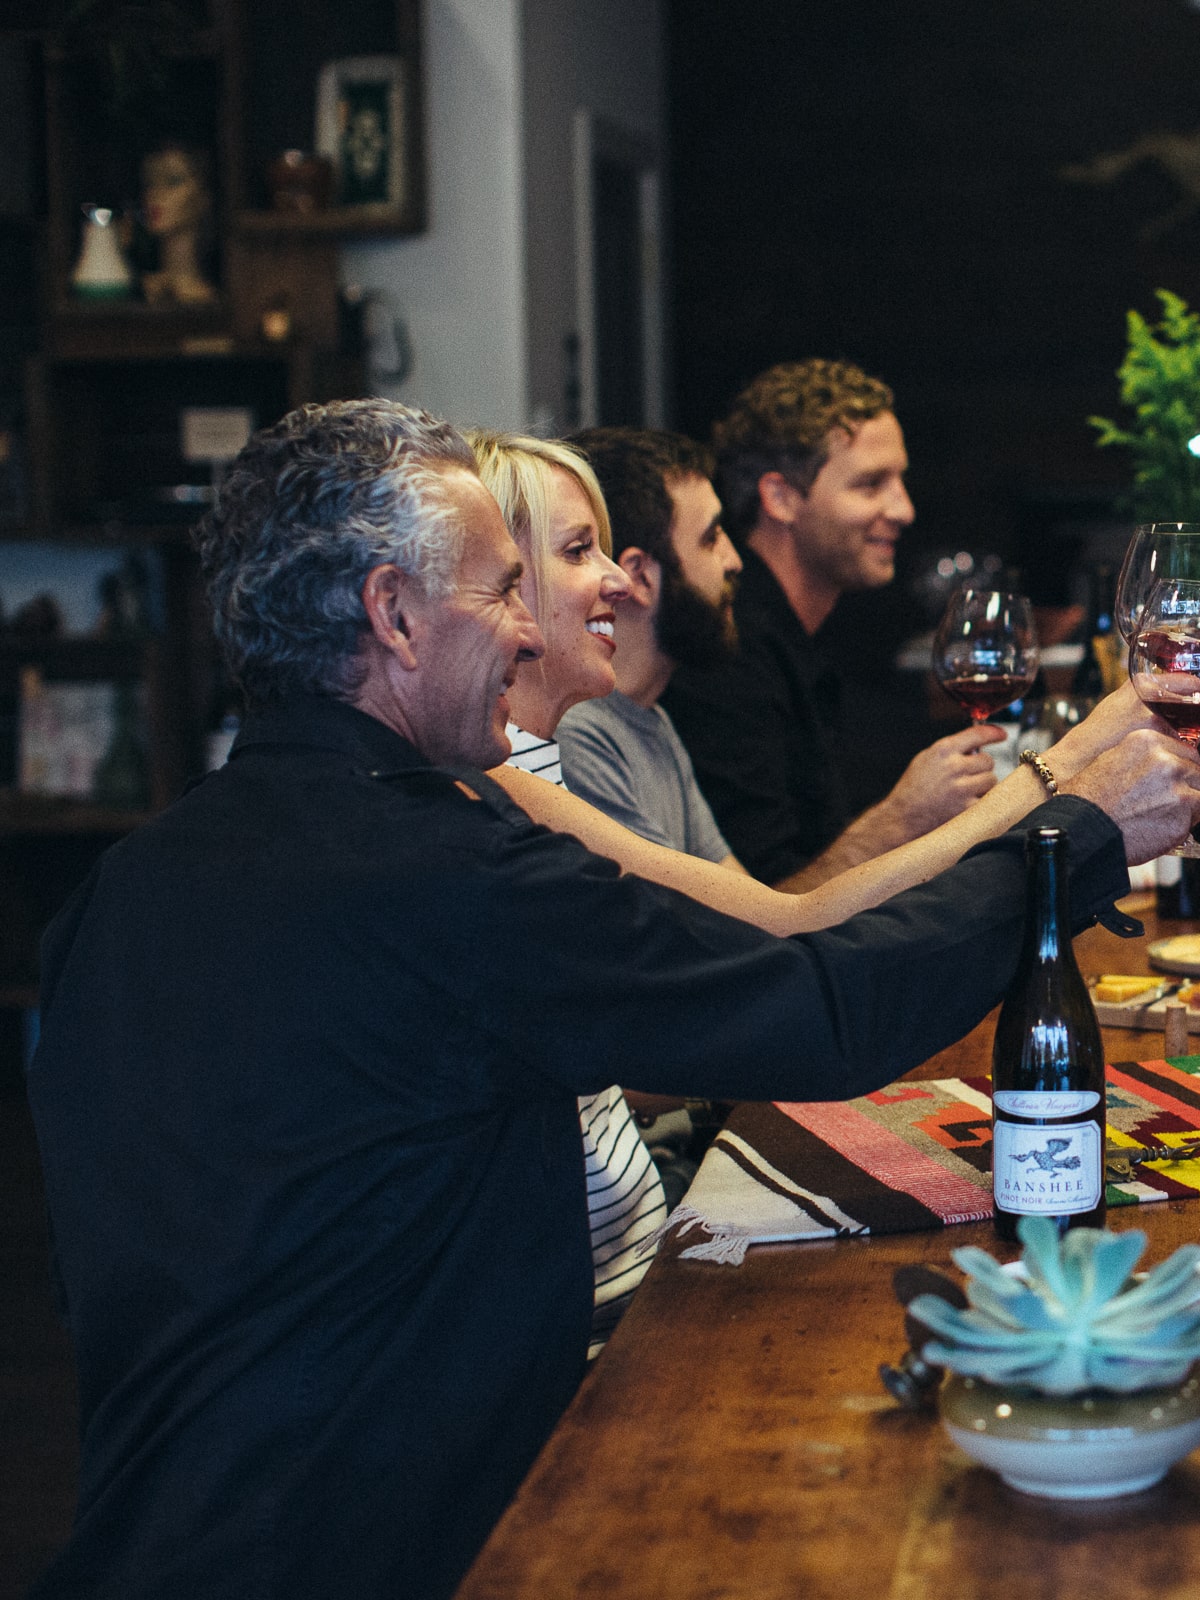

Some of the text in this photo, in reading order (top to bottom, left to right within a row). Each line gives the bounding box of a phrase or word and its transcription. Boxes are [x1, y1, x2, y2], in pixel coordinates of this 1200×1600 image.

[1004, 1179, 1083, 1192] BANSHEE
[1000, 1192, 1020, 1204] PINOT
[1021, 1196, 1042, 1204] NOIR
